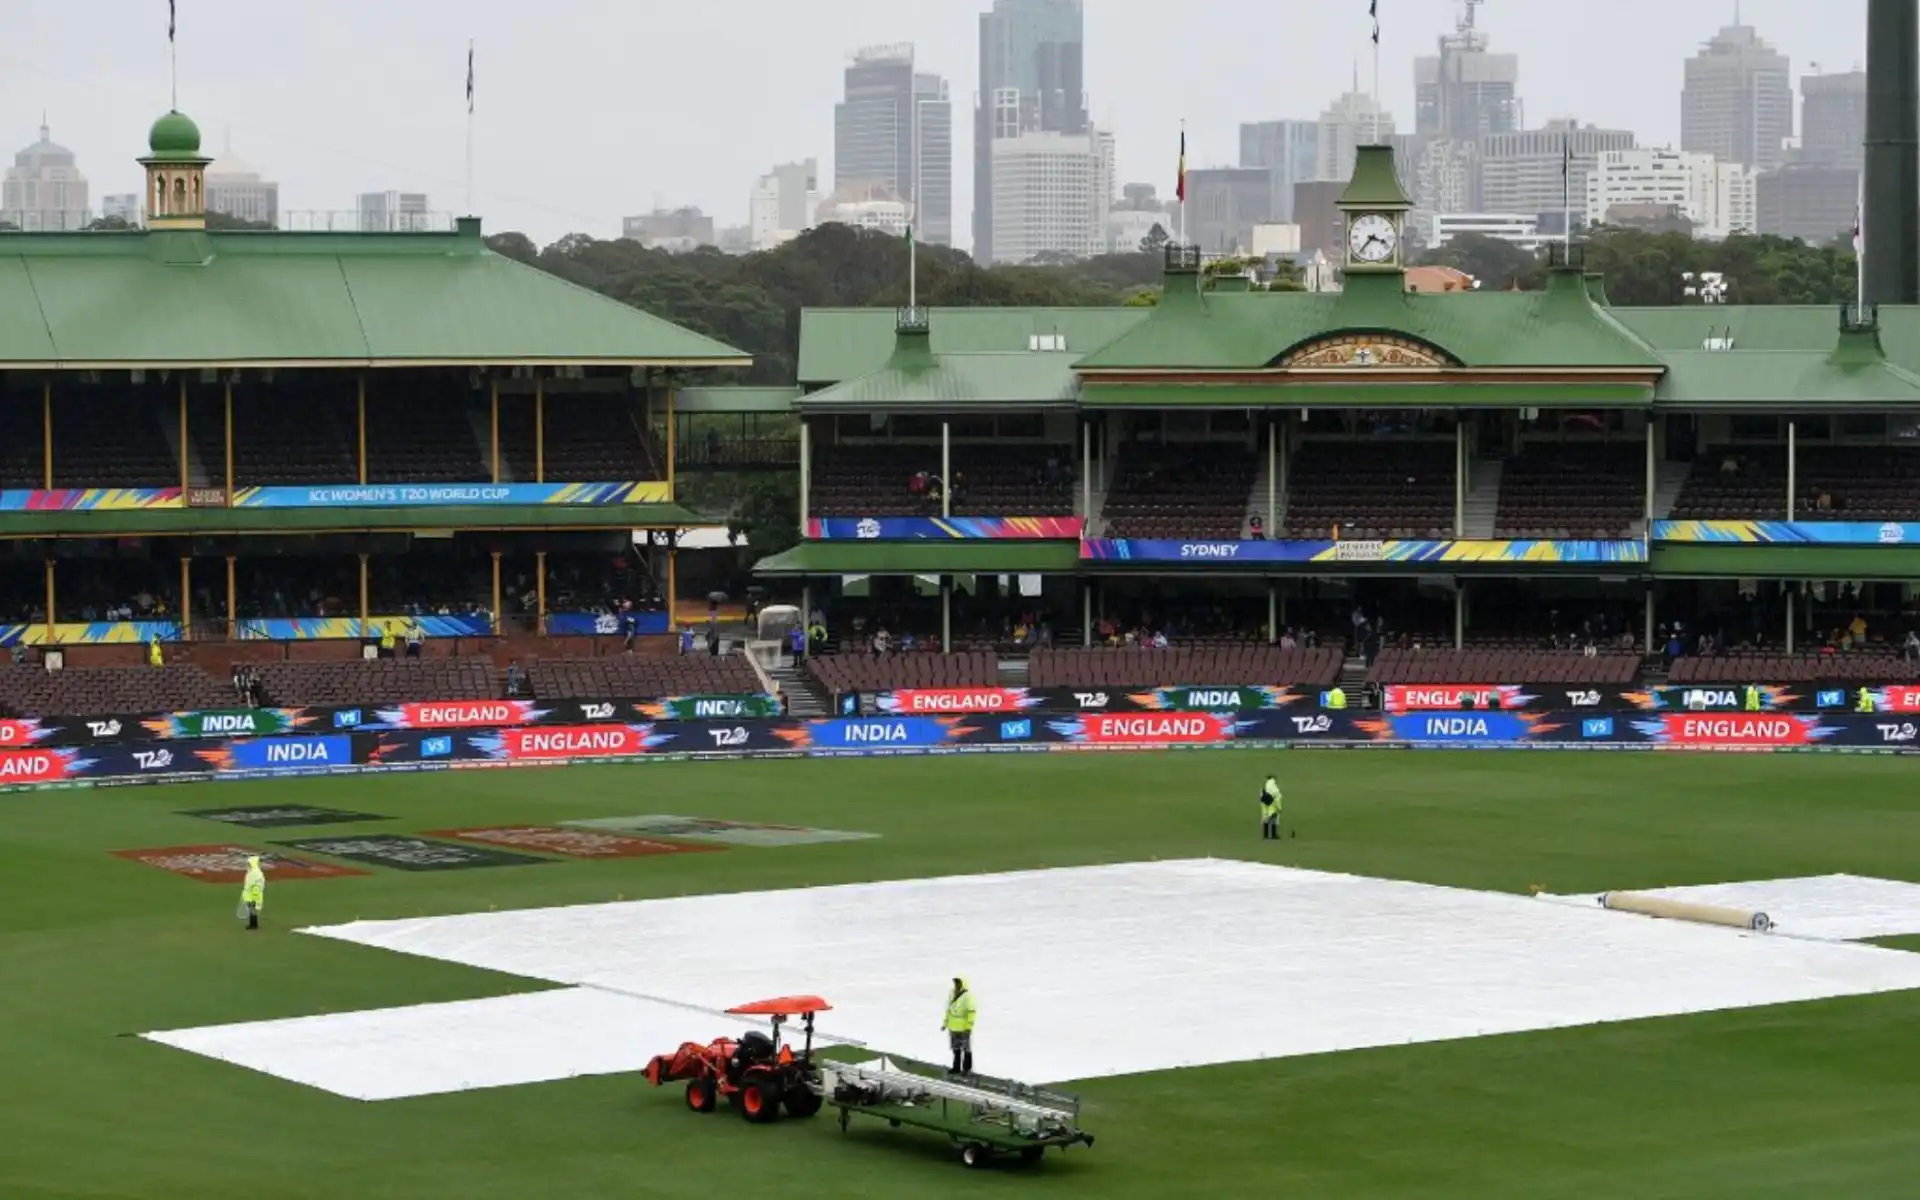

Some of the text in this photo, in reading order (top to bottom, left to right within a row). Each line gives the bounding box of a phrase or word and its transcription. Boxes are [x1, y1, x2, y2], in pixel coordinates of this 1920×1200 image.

[308, 486, 510, 501] ICC WOMEN'S T20 WORLD CUP
[1181, 544, 1239, 556] SYDNEY
[913, 693, 1002, 709] ENGLAND
[1188, 690, 1242, 706] INDIA
[1683, 690, 1738, 706] IDIA
[202, 714, 256, 732] INDIA
[419, 706, 509, 723] ENGLAND
[845, 723, 907, 741] INDIA
[1101, 719, 1205, 737] ENGLAND
[1427, 718, 1488, 736] INDIA
[1683, 720, 1790, 738] ENGLAND
[267, 742, 328, 762] INDIA
[521, 731, 625, 752] ENGLAND
